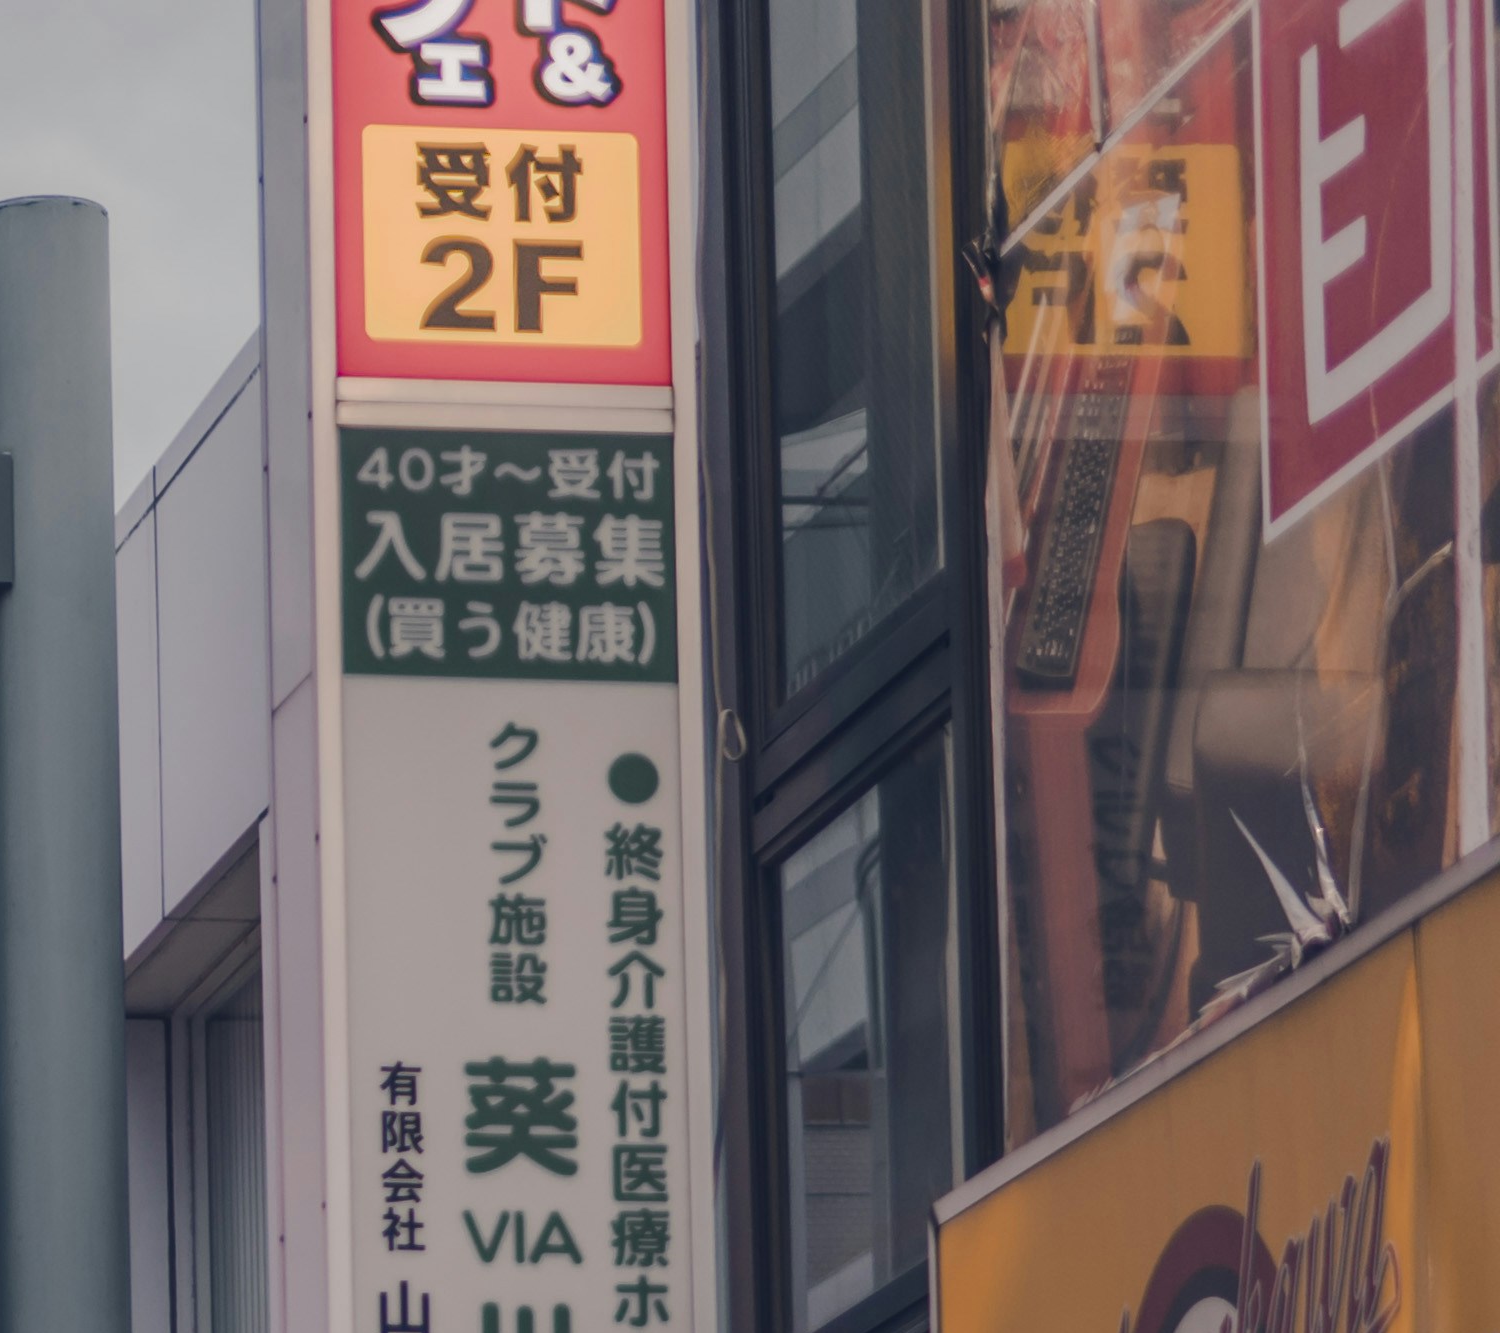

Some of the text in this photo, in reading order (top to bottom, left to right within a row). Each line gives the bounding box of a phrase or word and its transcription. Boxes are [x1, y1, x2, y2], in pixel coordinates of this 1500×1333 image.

[414, 141, 585, 224] 受付
[418, 234, 586, 334] 2F
[354, 509, 666, 589] 入居募集
[365, 593, 657, 666] (買う健康)
[488, 721, 548, 1006] クラブ施設
